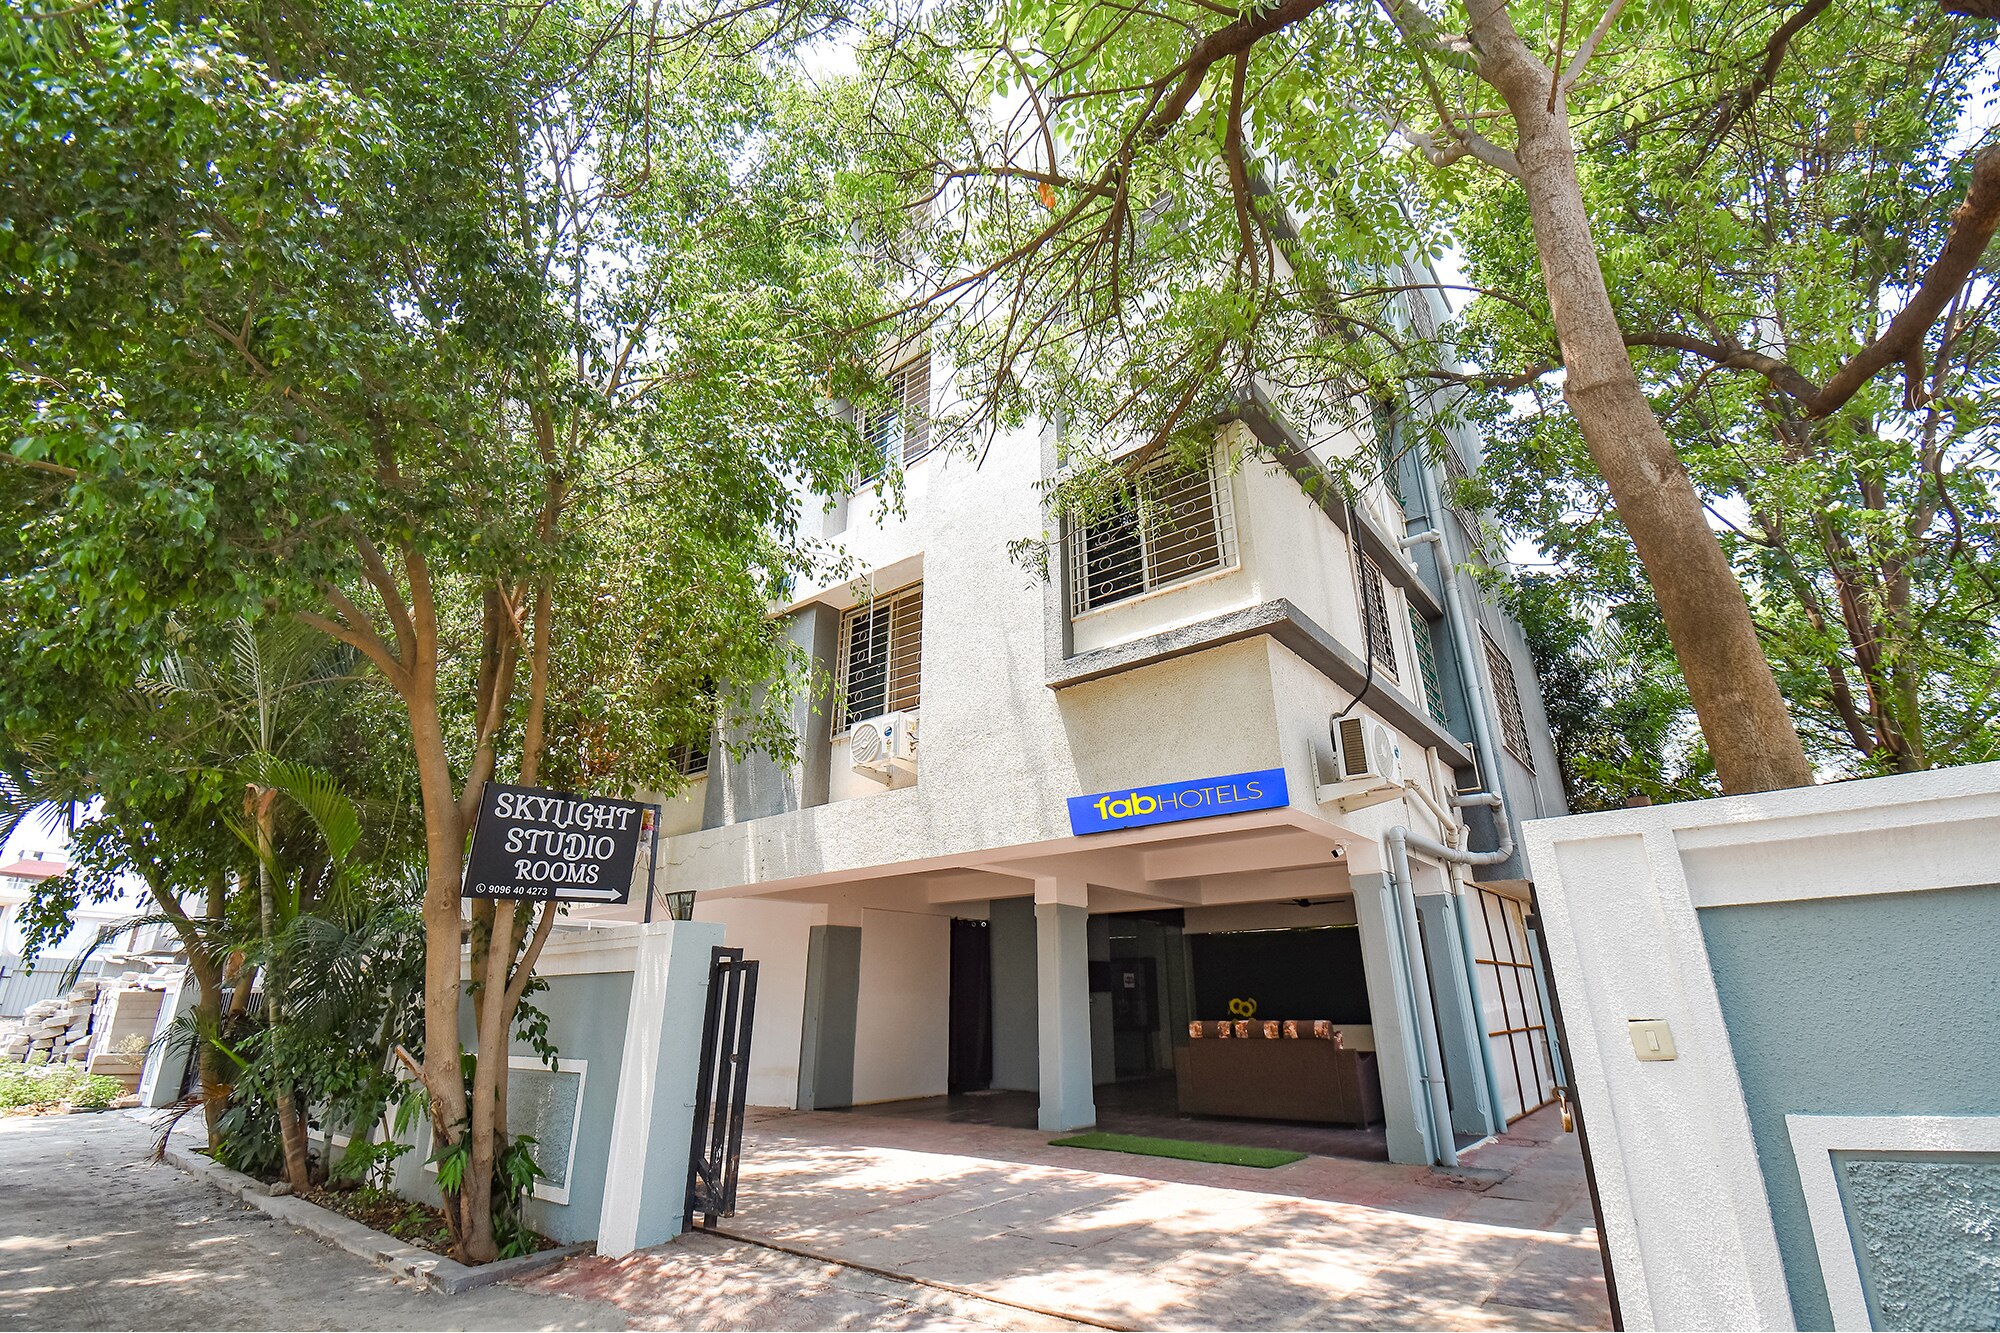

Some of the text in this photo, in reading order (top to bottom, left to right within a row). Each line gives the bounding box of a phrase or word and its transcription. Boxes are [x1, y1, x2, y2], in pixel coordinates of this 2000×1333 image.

[494, 792, 636, 831] SKYLIGHT
[1093, 781, 1263, 820] fabHOTELS
[504, 827, 615, 861] STUDIO
[514, 859, 600, 884] ROOMS
[488, 884, 548, 896] 9096 40 4273
